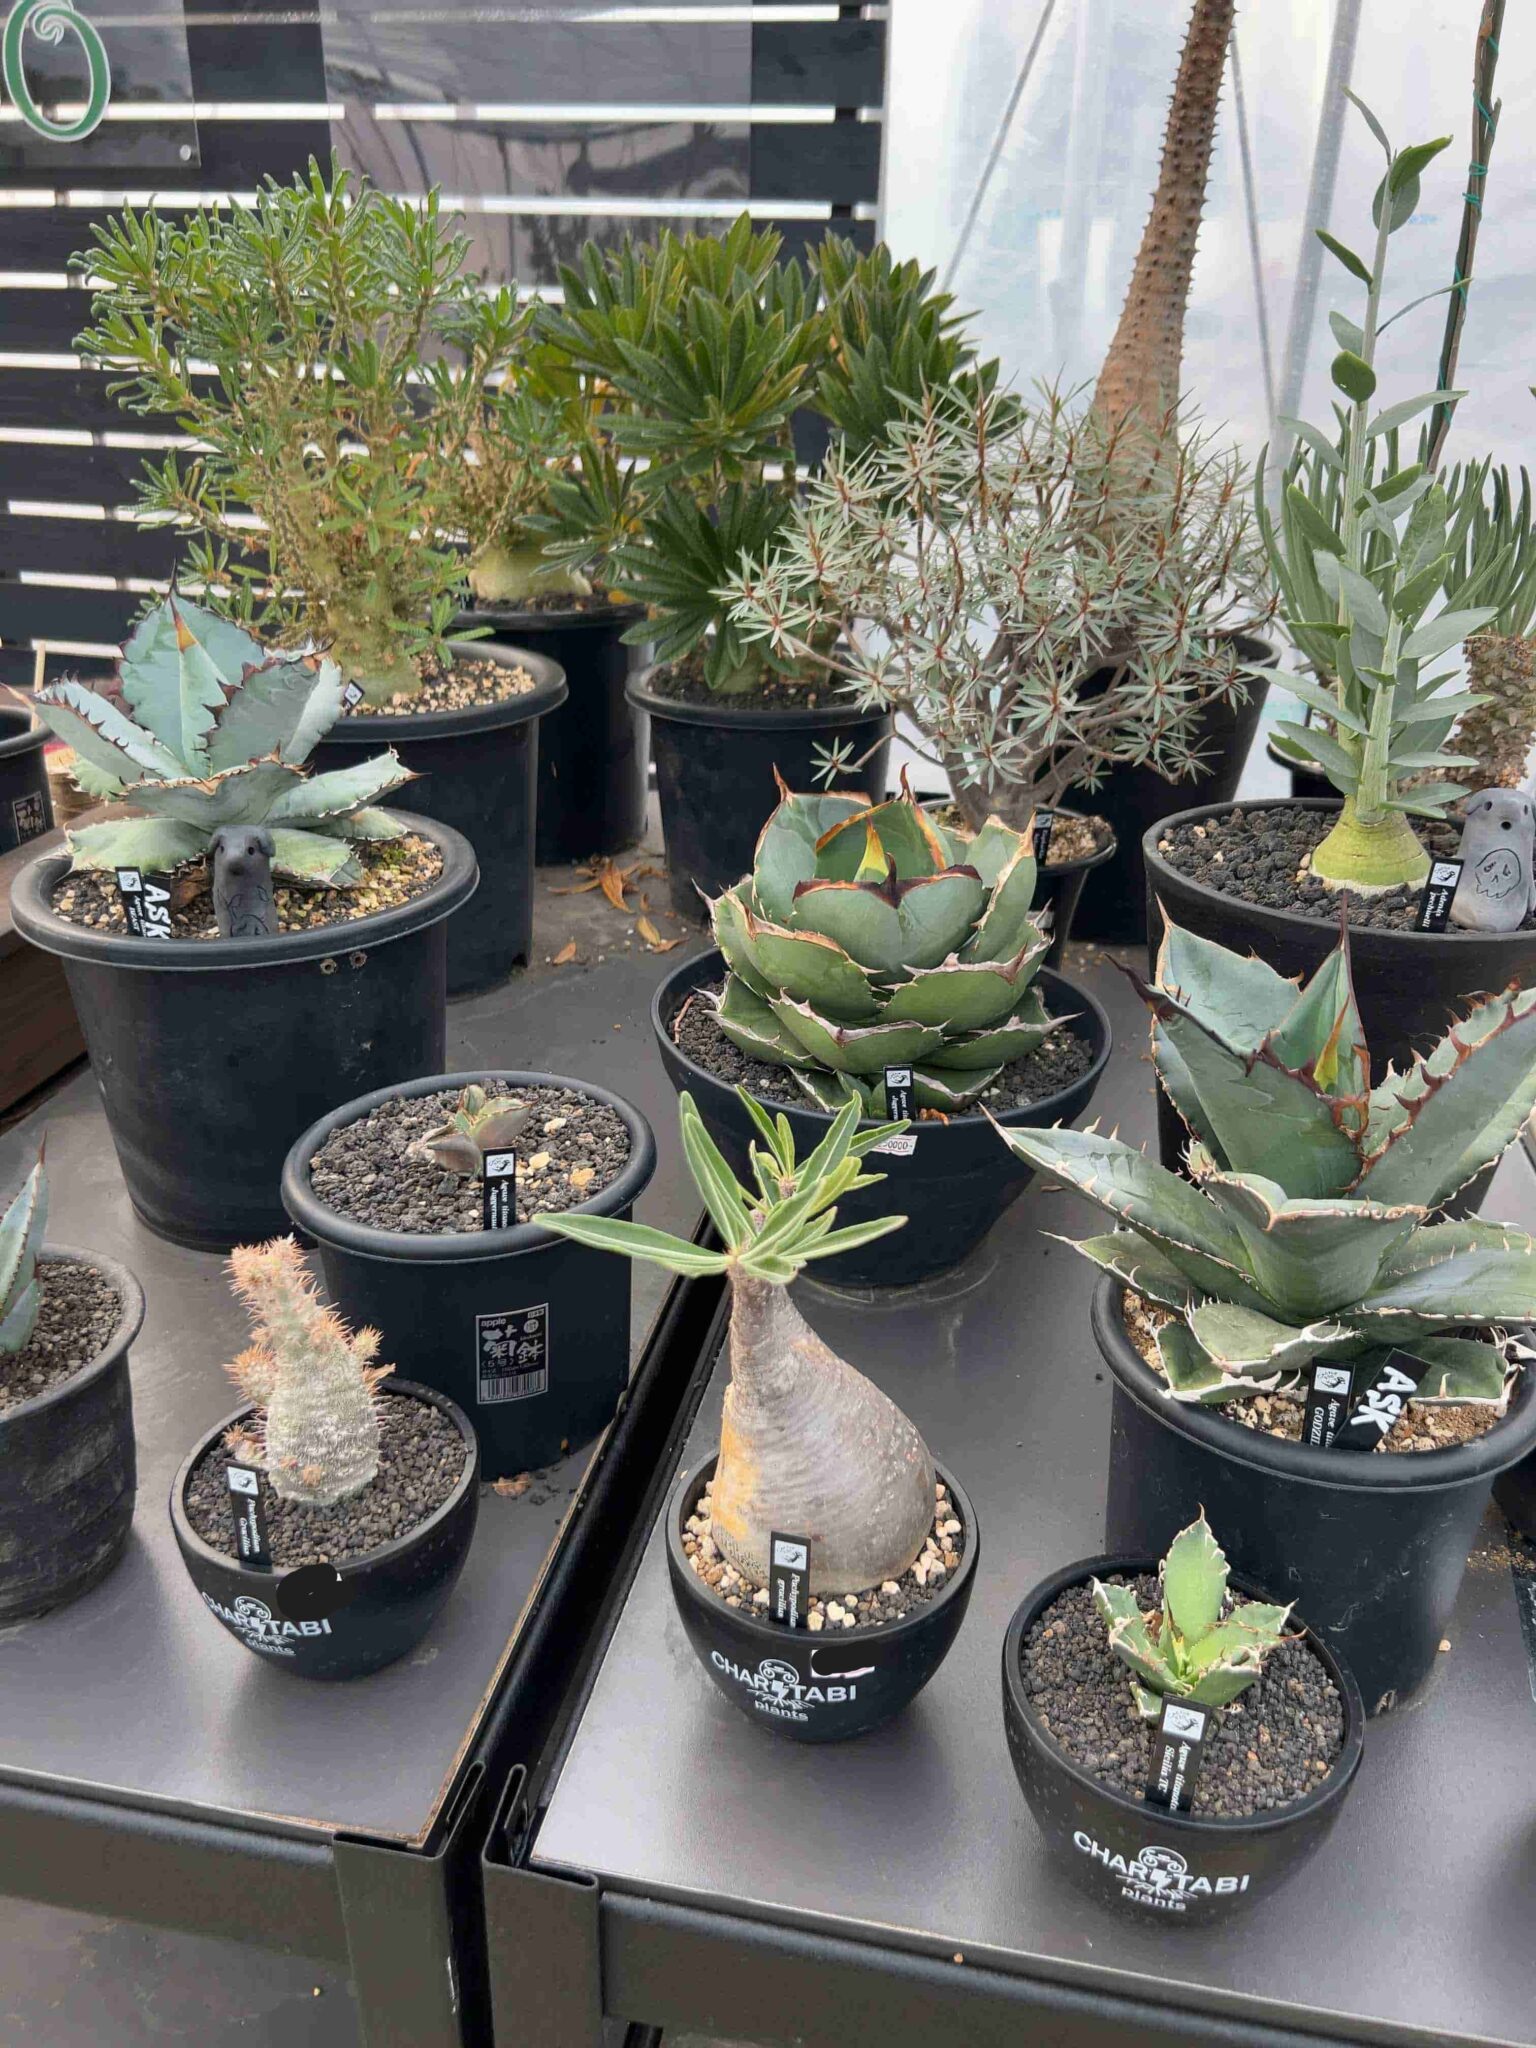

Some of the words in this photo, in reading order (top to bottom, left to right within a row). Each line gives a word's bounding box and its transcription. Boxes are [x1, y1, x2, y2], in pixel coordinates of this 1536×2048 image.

[144, 883, 172, 940] ASK
[1328, 1398, 1340, 1429] Agave
[1350, 1365, 1418, 1435] ASK
[1160, 1744, 1175, 1777] Sicilia
